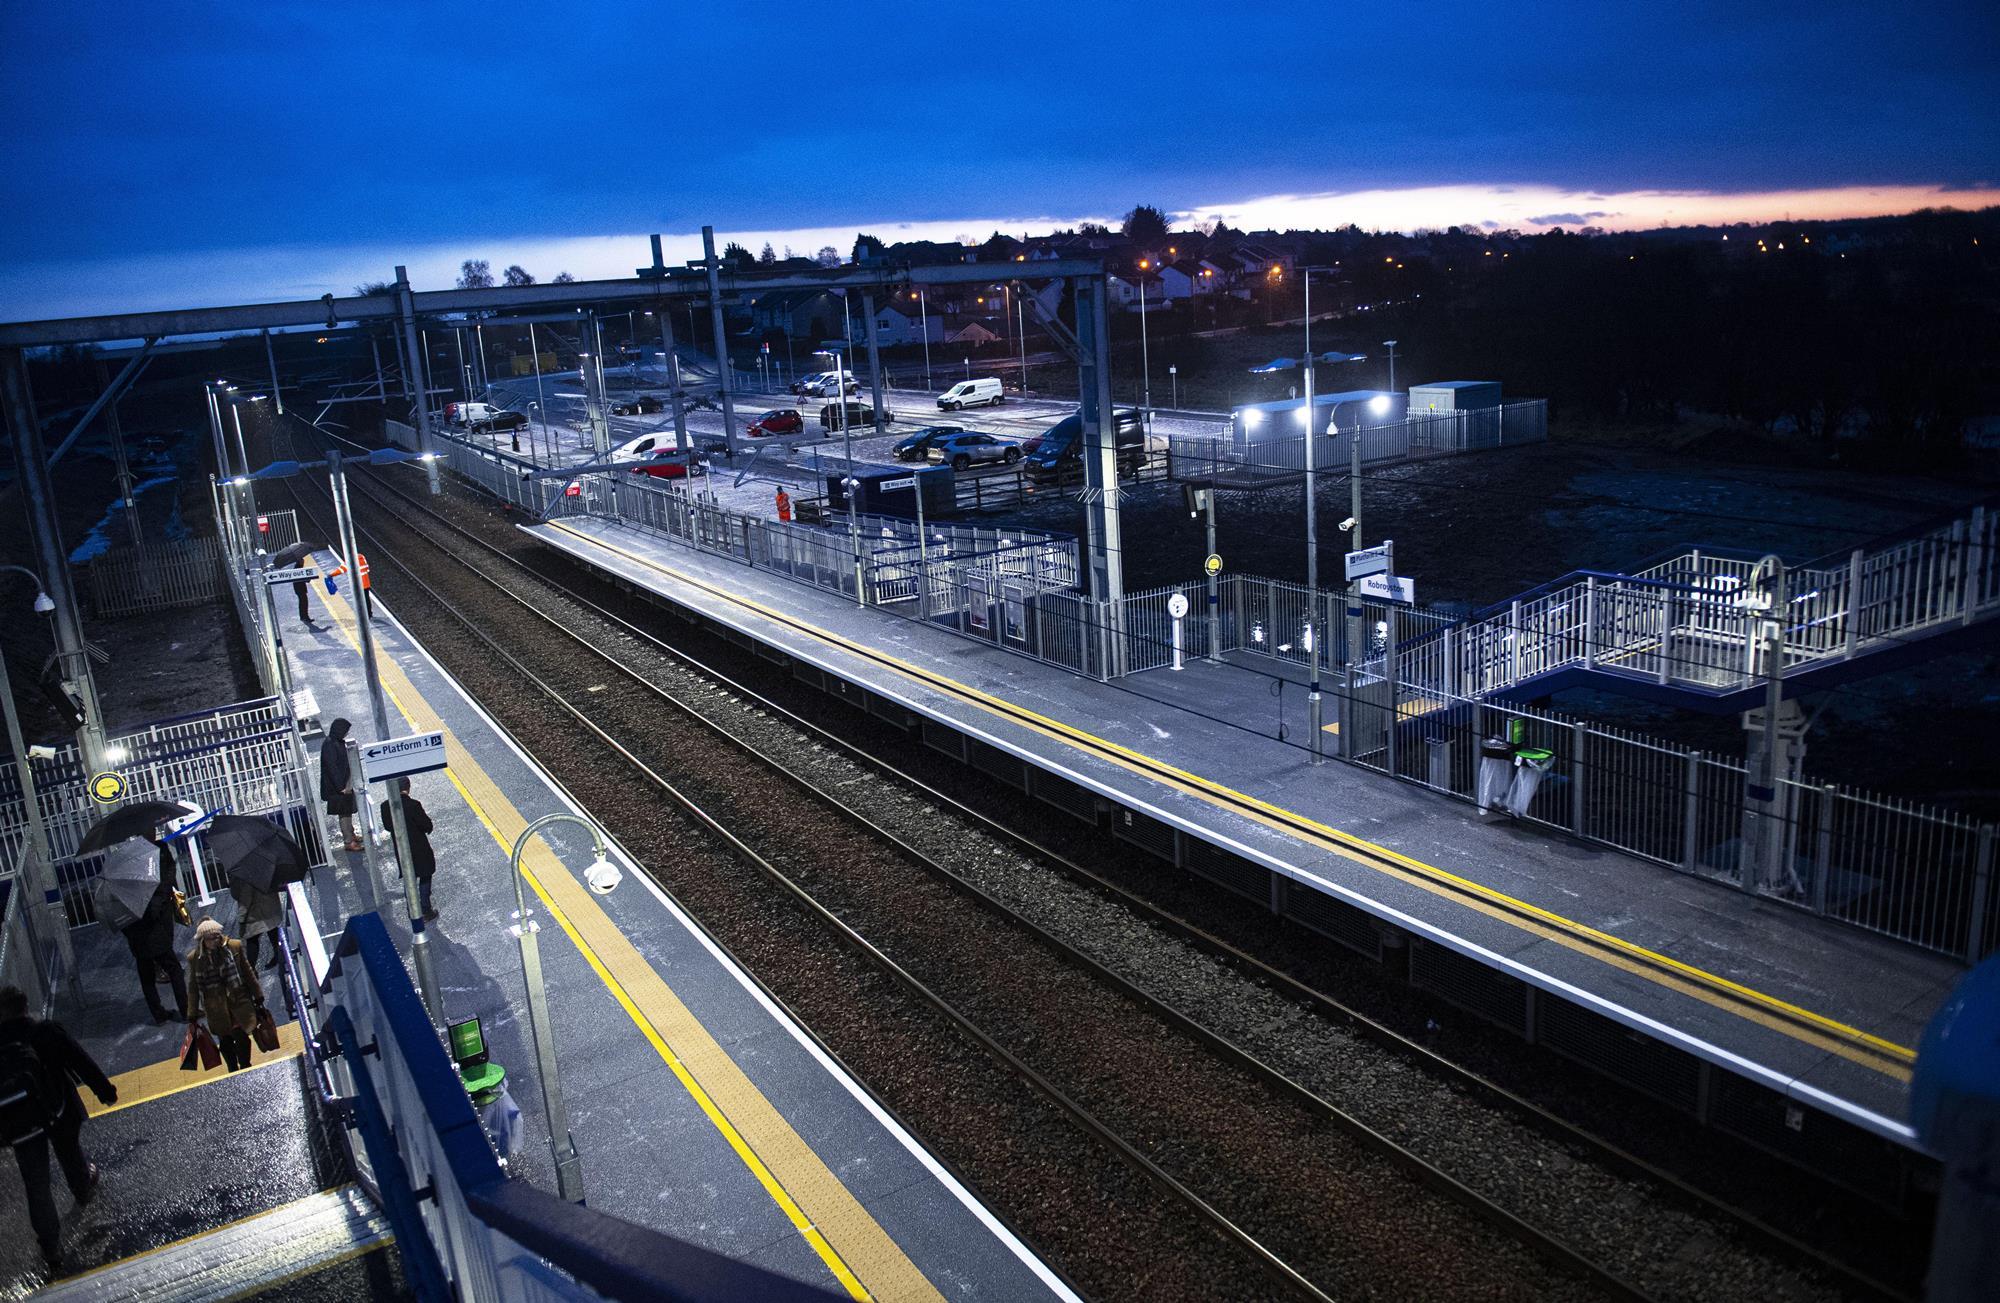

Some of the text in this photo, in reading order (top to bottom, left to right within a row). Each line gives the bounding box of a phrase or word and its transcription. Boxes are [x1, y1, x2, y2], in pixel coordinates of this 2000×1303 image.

[1367, 580, 1405, 593] Robroyston
[382, 738, 429, 755] Platform 1
